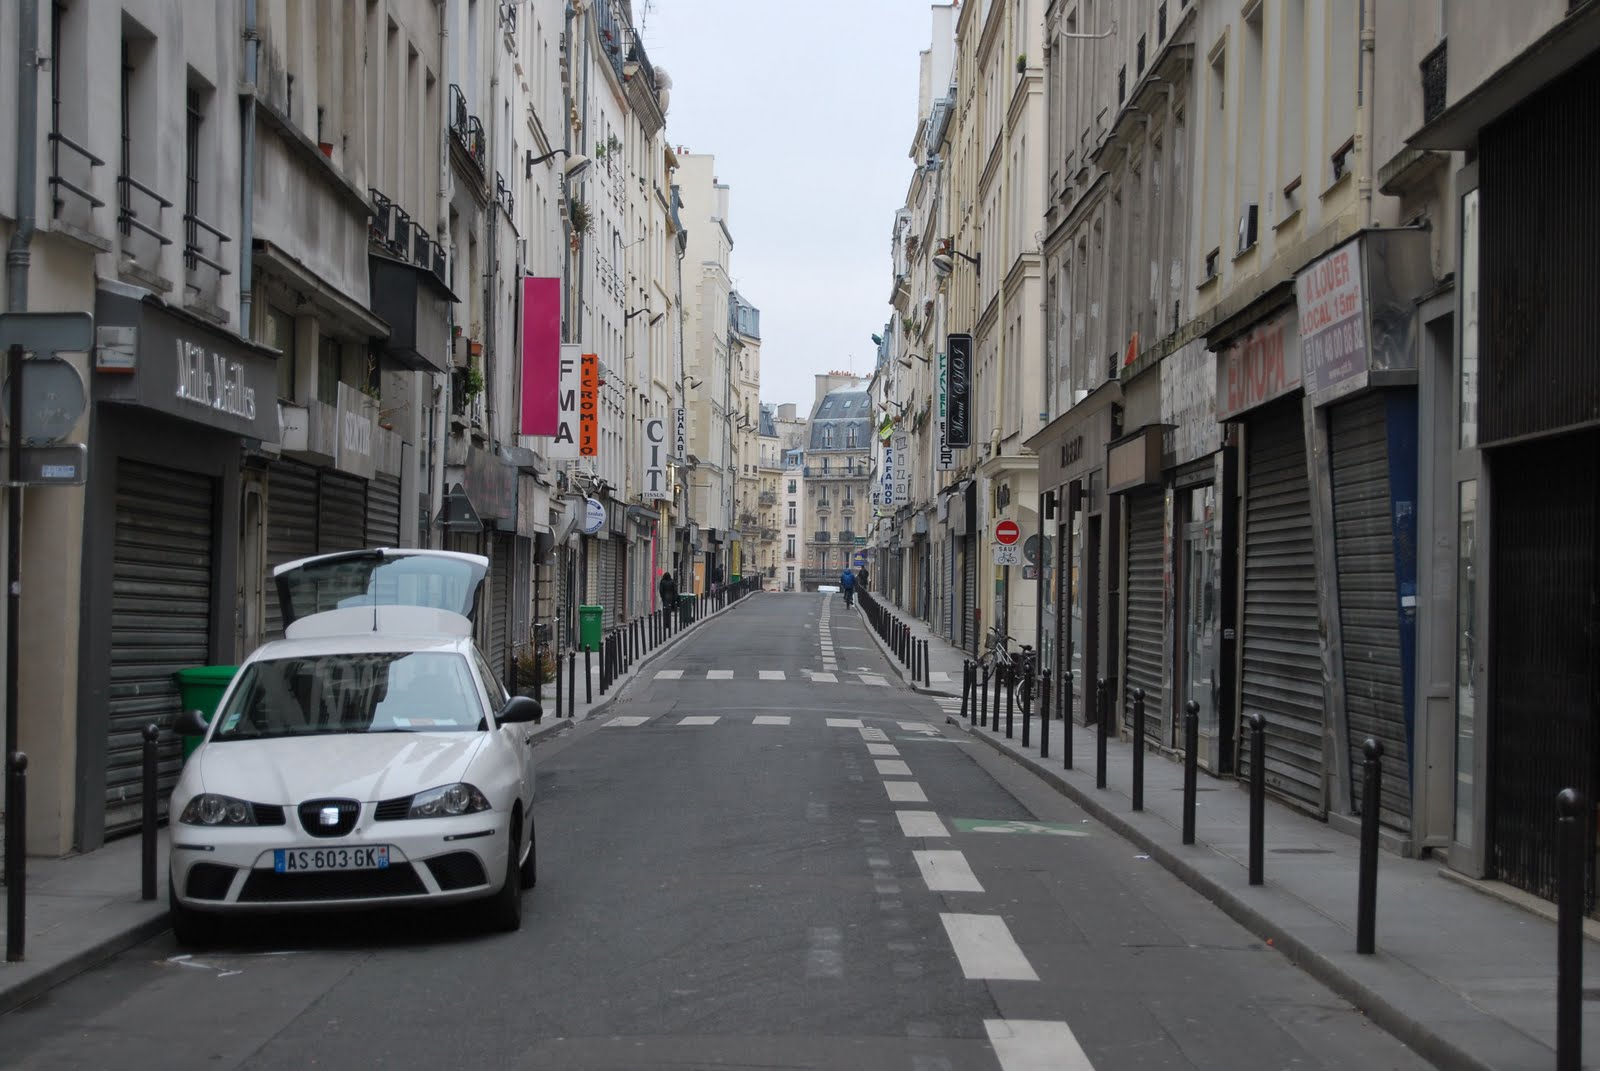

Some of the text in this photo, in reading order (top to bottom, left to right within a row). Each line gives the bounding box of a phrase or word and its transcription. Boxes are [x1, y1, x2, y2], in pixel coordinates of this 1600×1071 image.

[1315, 252, 1350, 298] LOUER
[1302, 301, 1331, 336] LOCAL
[1228, 327, 1285, 412] EUROPA
[580, 357, 594, 455] MICROMIJO
[646, 420, 664, 491] CIT
